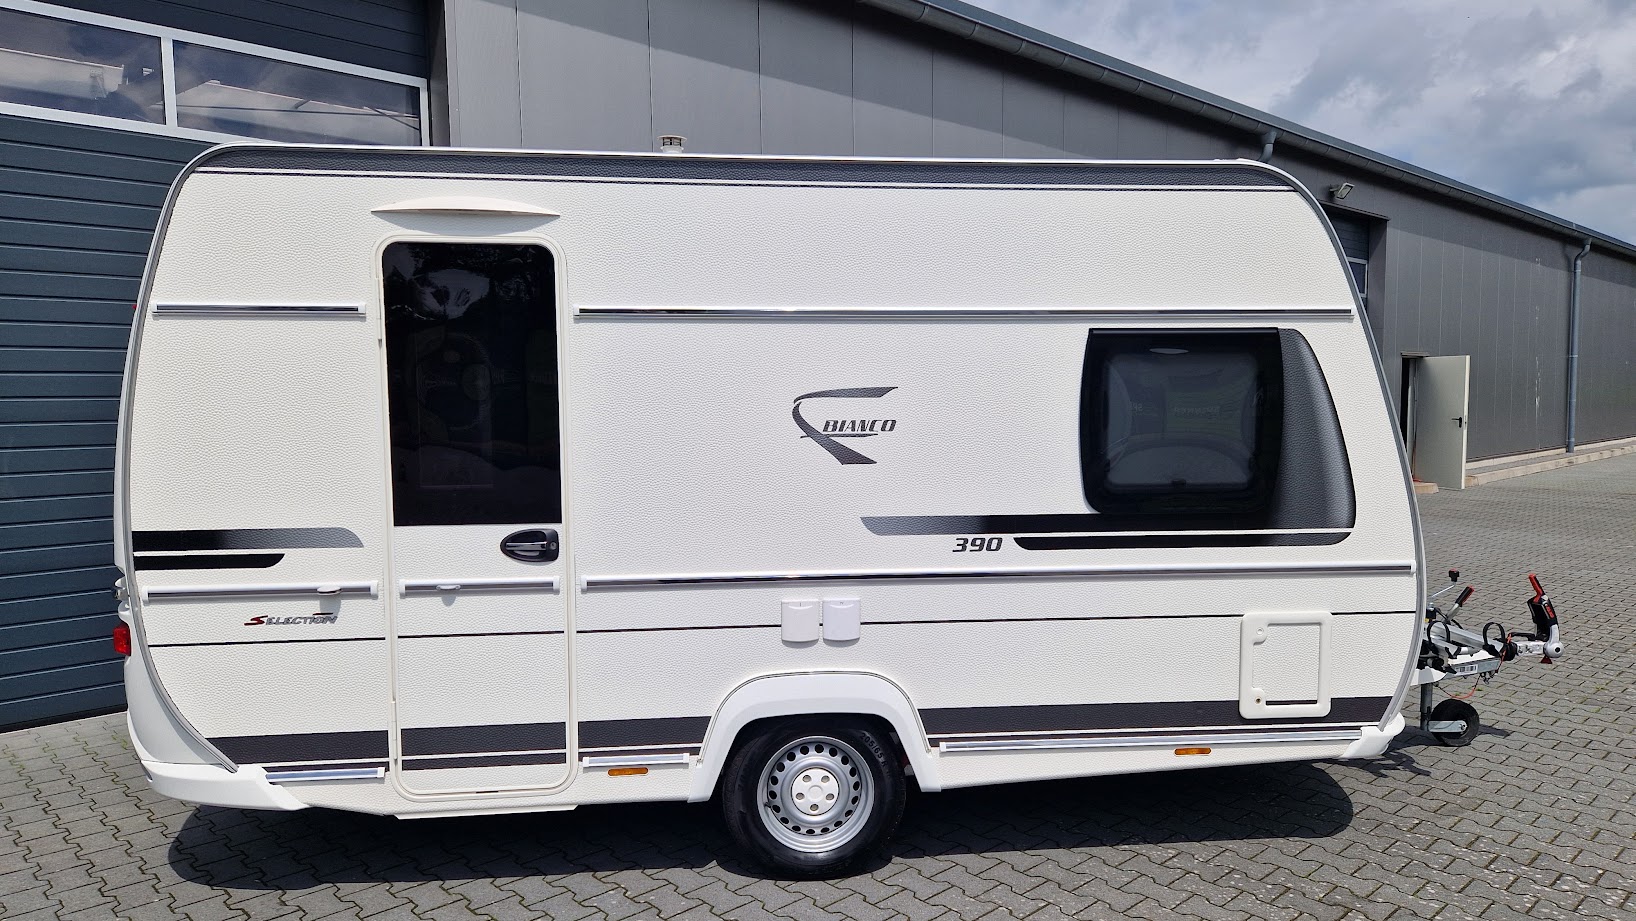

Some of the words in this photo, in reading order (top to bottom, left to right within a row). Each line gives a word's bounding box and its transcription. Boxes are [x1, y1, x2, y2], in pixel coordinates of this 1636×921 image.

[822, 419, 897, 433] BIANCO
[952, 537, 1003, 553] 390
[244, 613, 338, 626] SELECTION
